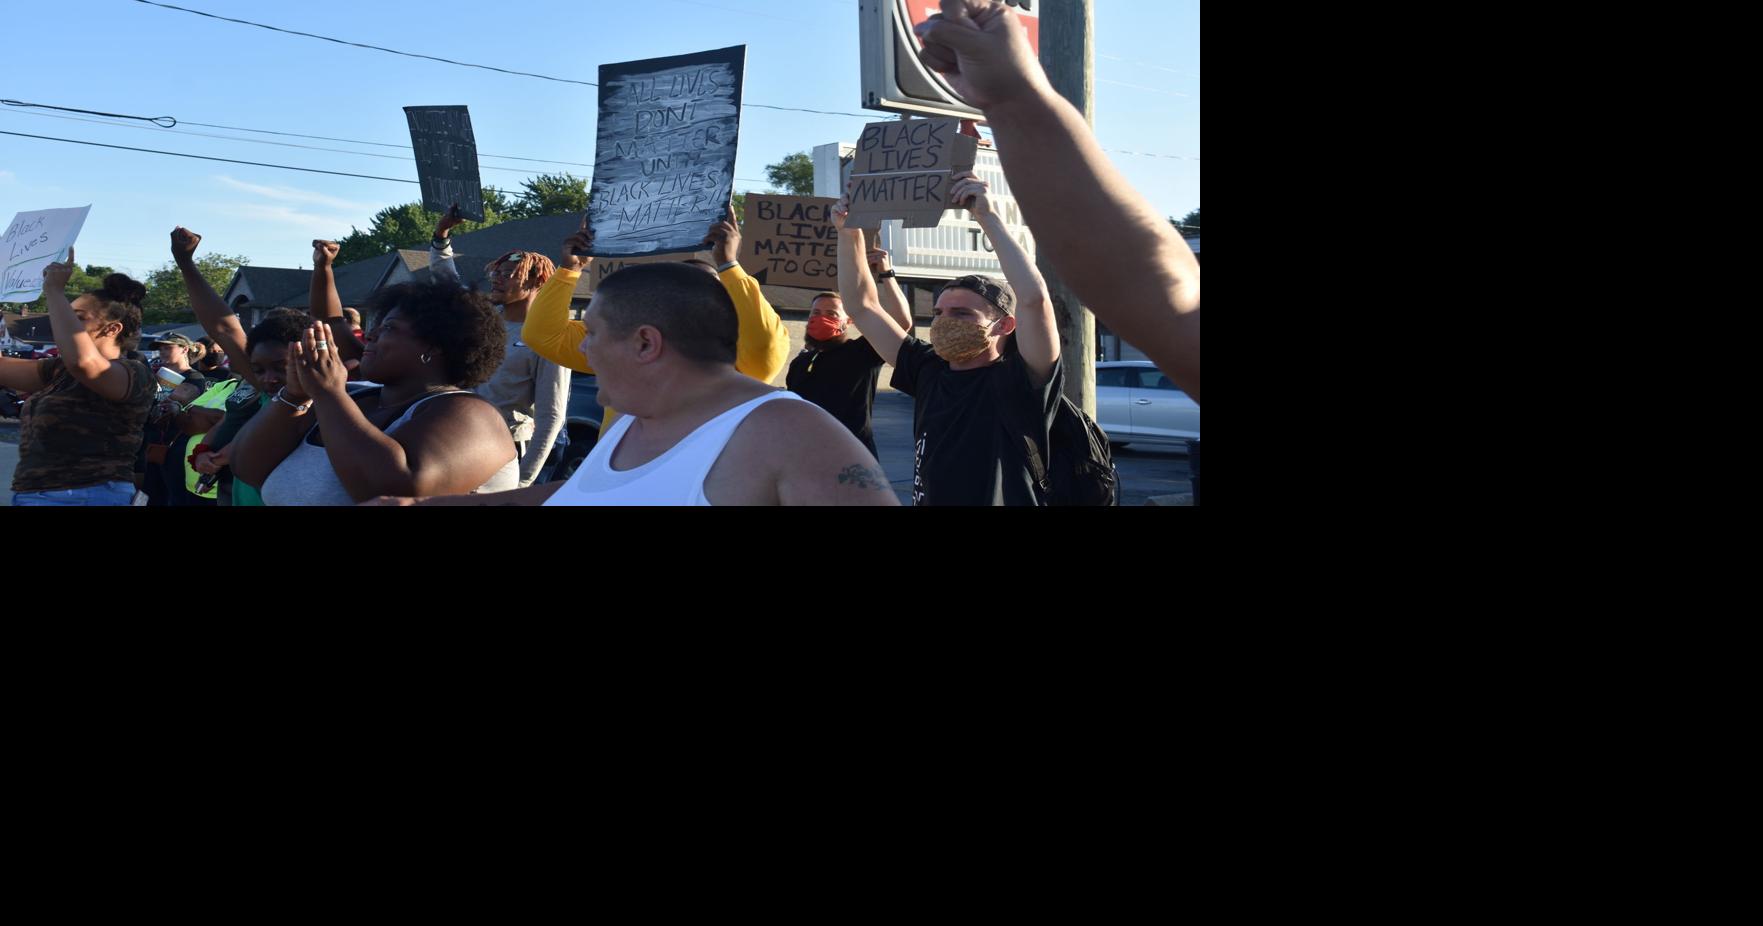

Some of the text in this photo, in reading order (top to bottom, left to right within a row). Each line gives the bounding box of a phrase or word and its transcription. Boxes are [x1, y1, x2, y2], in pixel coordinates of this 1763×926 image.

[861, 122, 948, 152] BLACK
[867, 144, 942, 174] LIVES
[600, 169, 720, 210] BLACK LIVES
[852, 174, 943, 204] MATTER
[775, 222, 838, 240] LIVE
[754, 238, 838, 257] MATTE
